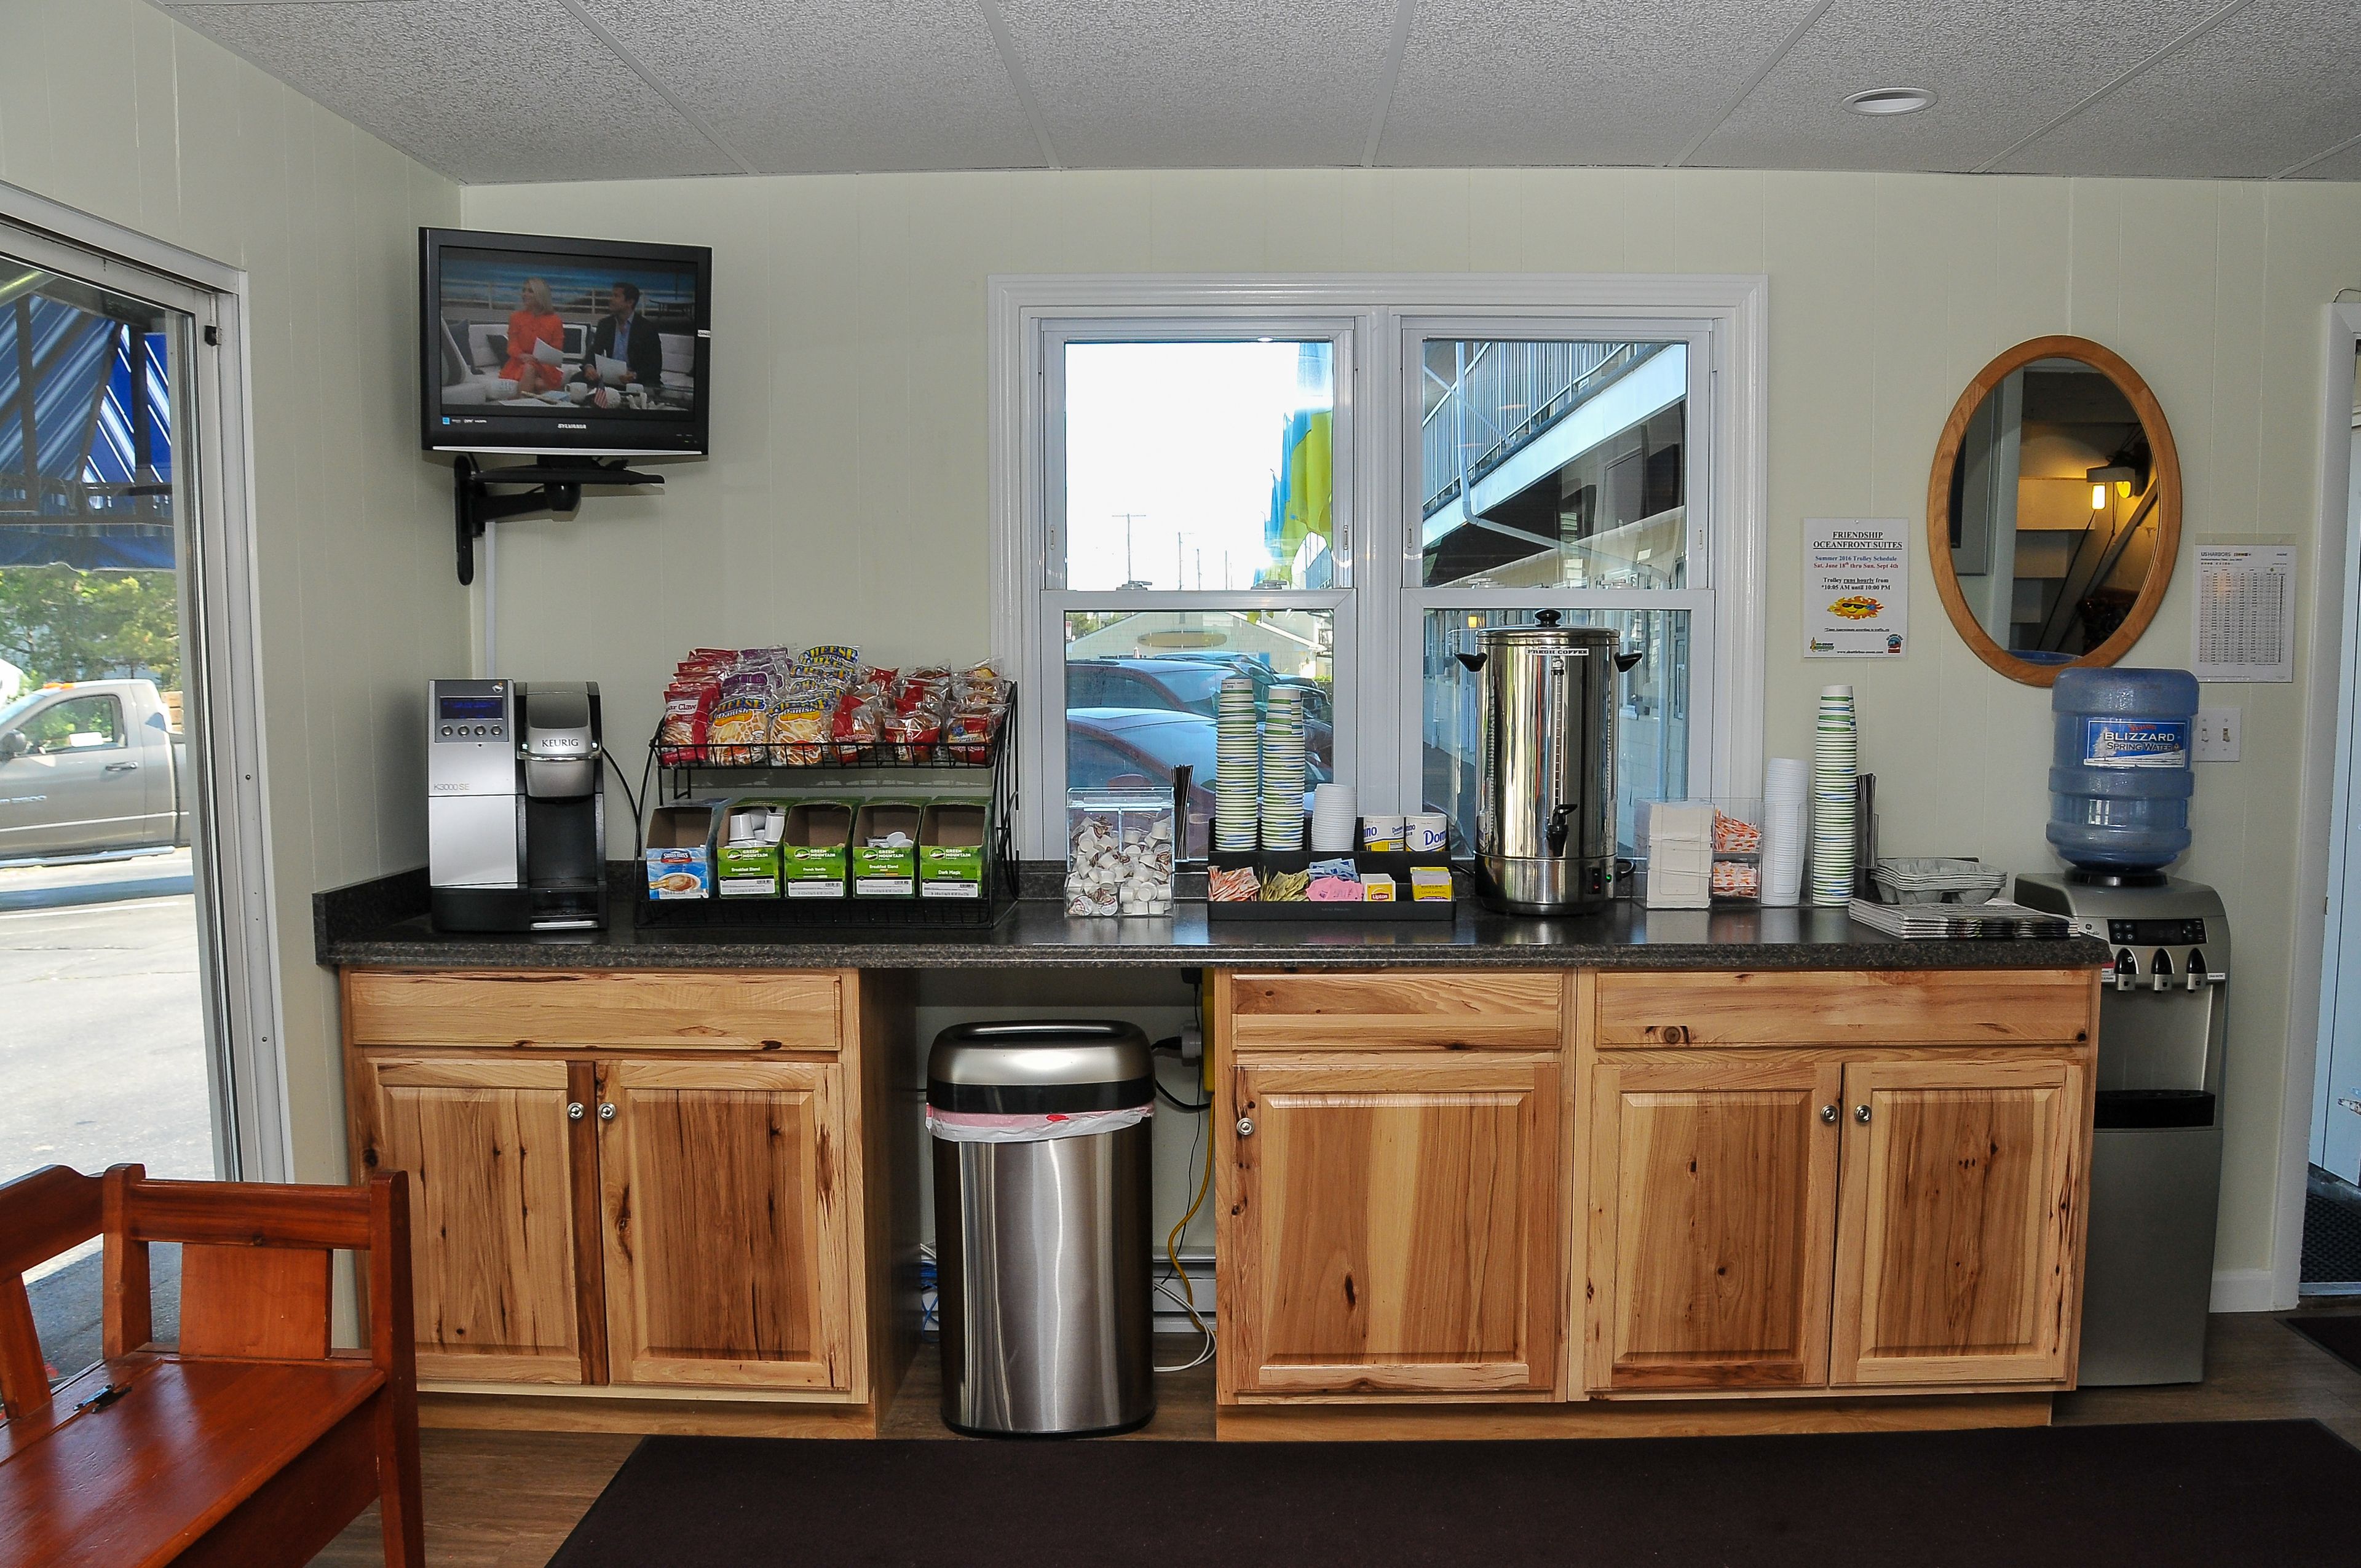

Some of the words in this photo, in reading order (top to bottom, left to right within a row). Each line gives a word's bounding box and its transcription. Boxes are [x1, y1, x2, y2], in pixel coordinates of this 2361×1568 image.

[1873, 541, 1902, 550] SUITES
[718, 708, 749, 719] Danish
[783, 707, 816, 715] Danish
[2104, 732, 2175, 742] BLIZZARD
[542, 738, 579, 748] KEURIG
[2107, 742, 2142, 751] SPRING
[2143, 743, 2173, 751] WATER
